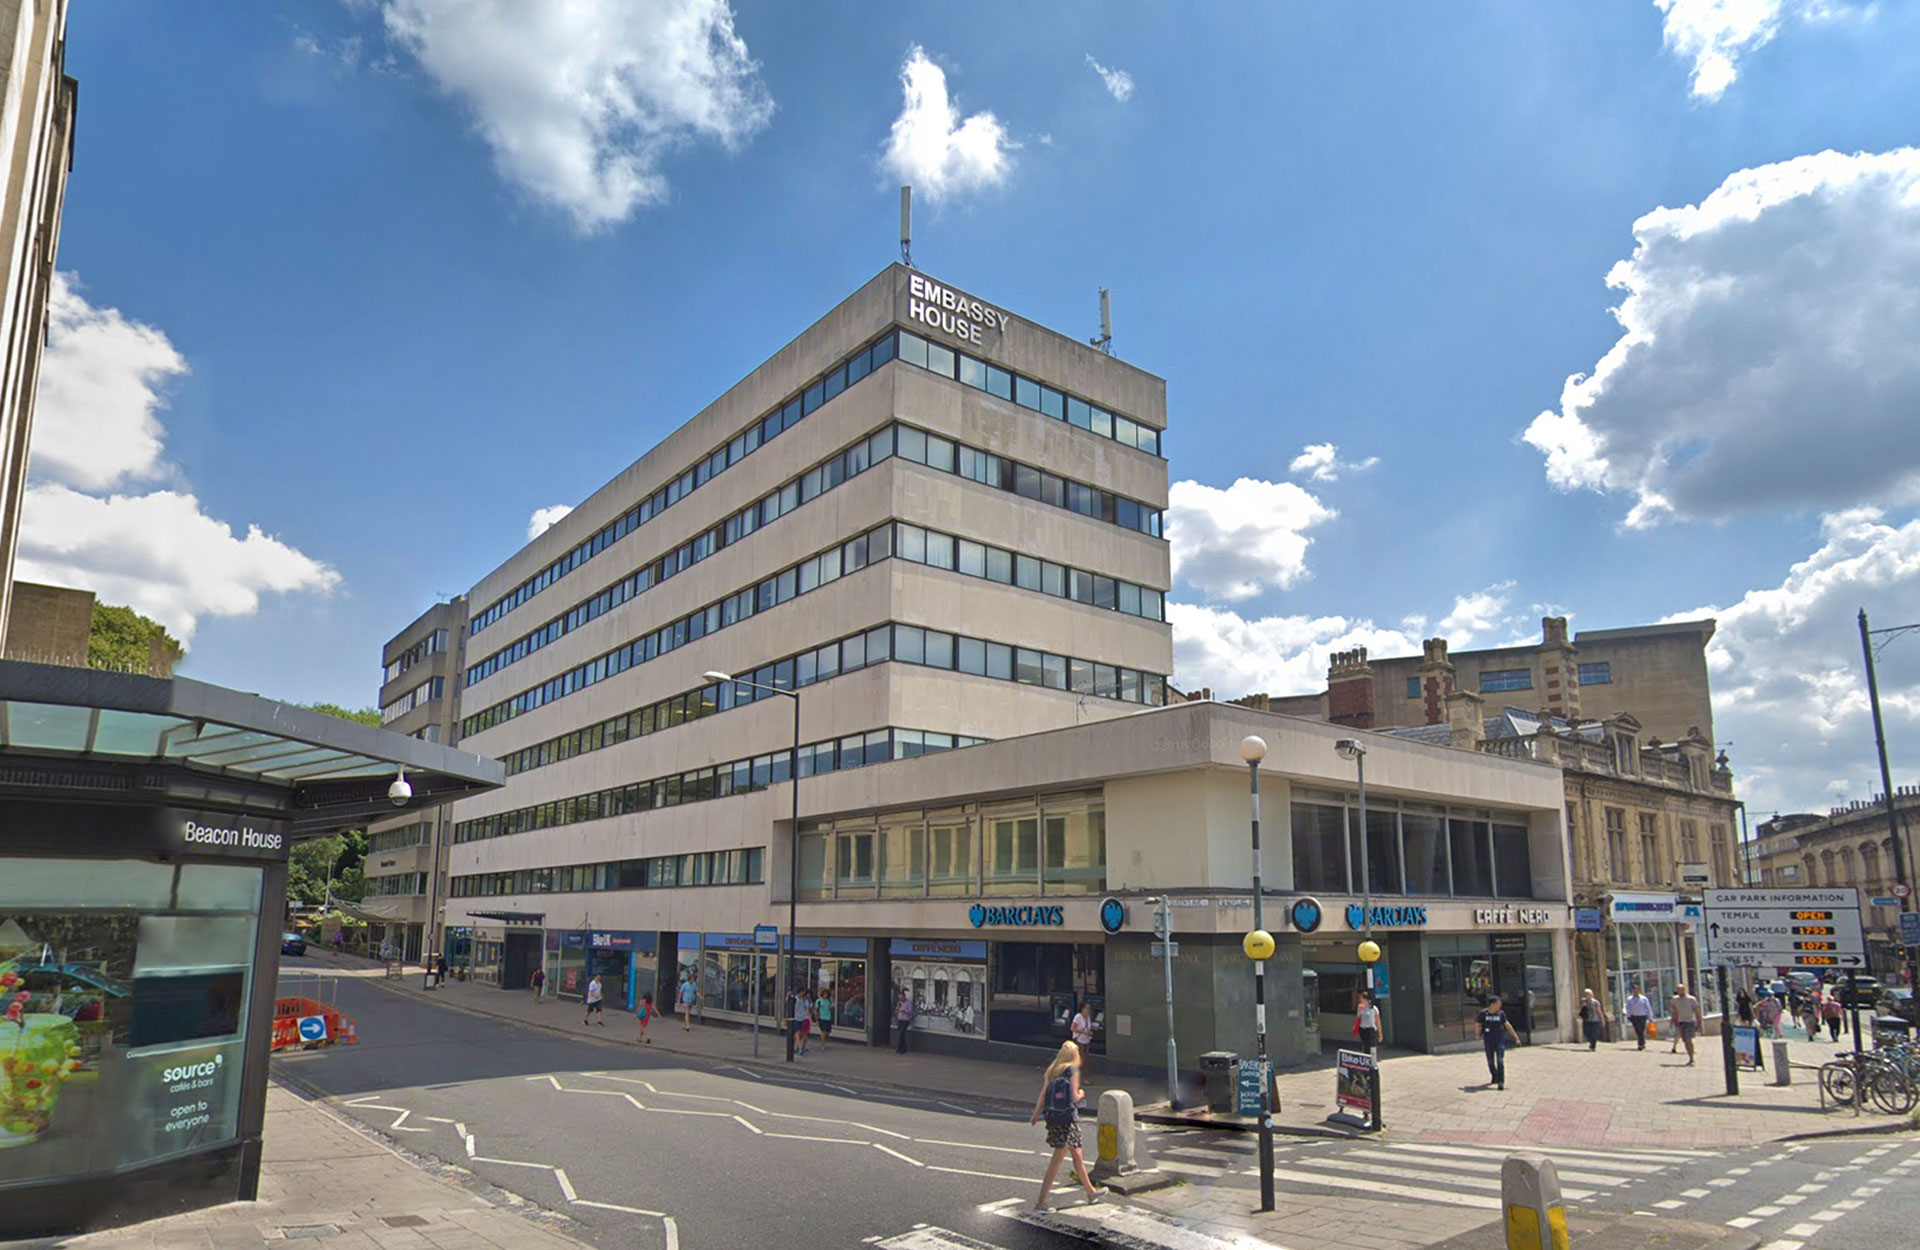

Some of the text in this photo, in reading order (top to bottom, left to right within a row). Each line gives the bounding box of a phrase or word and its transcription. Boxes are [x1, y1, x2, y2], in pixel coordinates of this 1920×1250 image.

[910, 274, 1009, 332] EMBASSY
[910, 298, 982, 345] HOUSE
[184, 821, 282, 849] Beacon House
[1715, 894, 1845, 902] CAR PARK INFORMATION
[986, 905, 1064, 926] BARCLAYS
[1367, 905, 1428, 926] BARCLAYS
[1517, 909, 1551, 924] NERO
[1721, 911, 1826, 920] TEMPLE OPEN
[1723, 926, 1788, 935] BROADMEAD
[1724, 941, 1830, 951] CENTRE 1072
[1725, 956, 1755, 964] WEST
[197, 1077, 214, 1088] bars
[170, 1100, 208, 1119] open to
[165, 1114, 210, 1132] everyone
